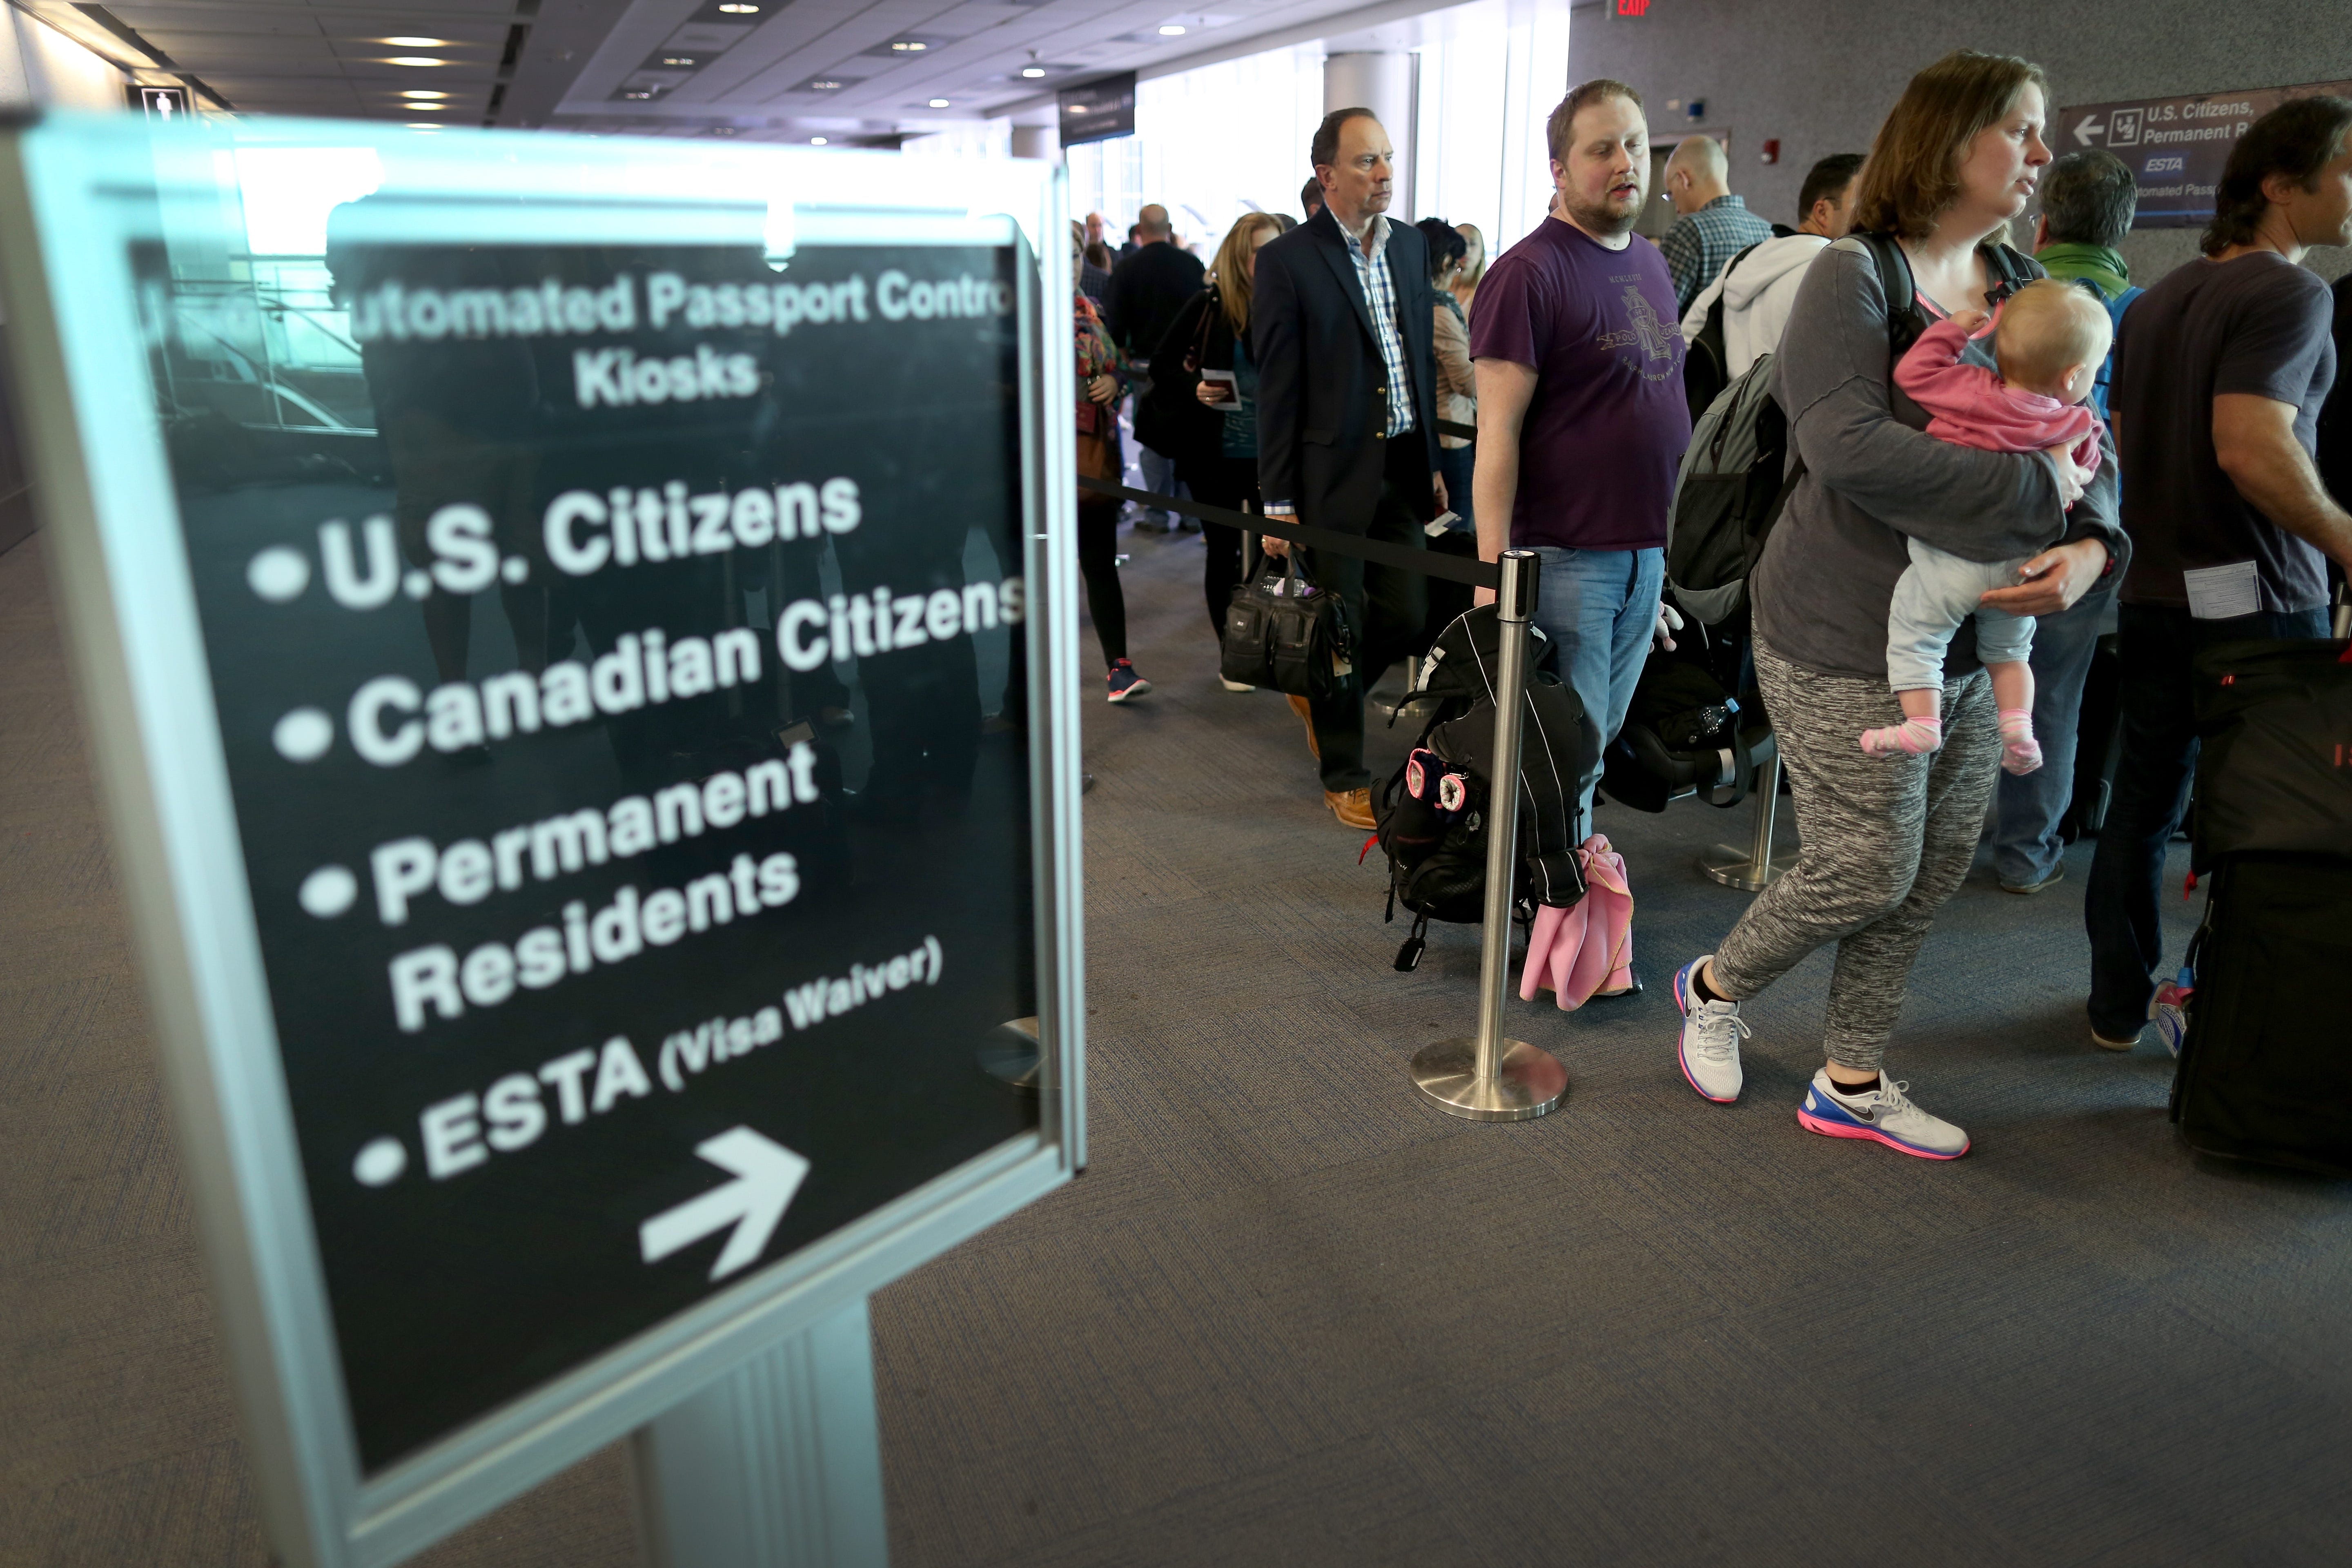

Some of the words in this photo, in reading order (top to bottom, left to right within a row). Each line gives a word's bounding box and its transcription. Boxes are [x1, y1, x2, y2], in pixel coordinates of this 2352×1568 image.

[2144, 123, 2231, 144] Permanent
[2147, 105, 2178, 122] U.S.
[2182, 102, 2254, 120] Citizens,
[2138, 186, 2183, 197] tomated
[2145, 157, 2183, 172] ESTA
[347, 274, 635, 342] utomated
[646, 270, 870, 336] Passport
[876, 268, 1013, 322] Contro
[1616, 333, 1636, 342] POLO
[574, 344, 762, 408] Kiosks
[320, 501, 530, 610] U.S.
[543, 474, 861, 576] Citizens
[347, 627, 763, 767] Canadian
[777, 576, 1026, 672] Citizens
[370, 739, 819, 927] Permanent
[389, 851, 800, 1032] Residents
[420, 1035, 651, 1180] ESTA
[659, 992, 782, 1091] (Visa
[784, 934, 944, 1031] Waiver)
